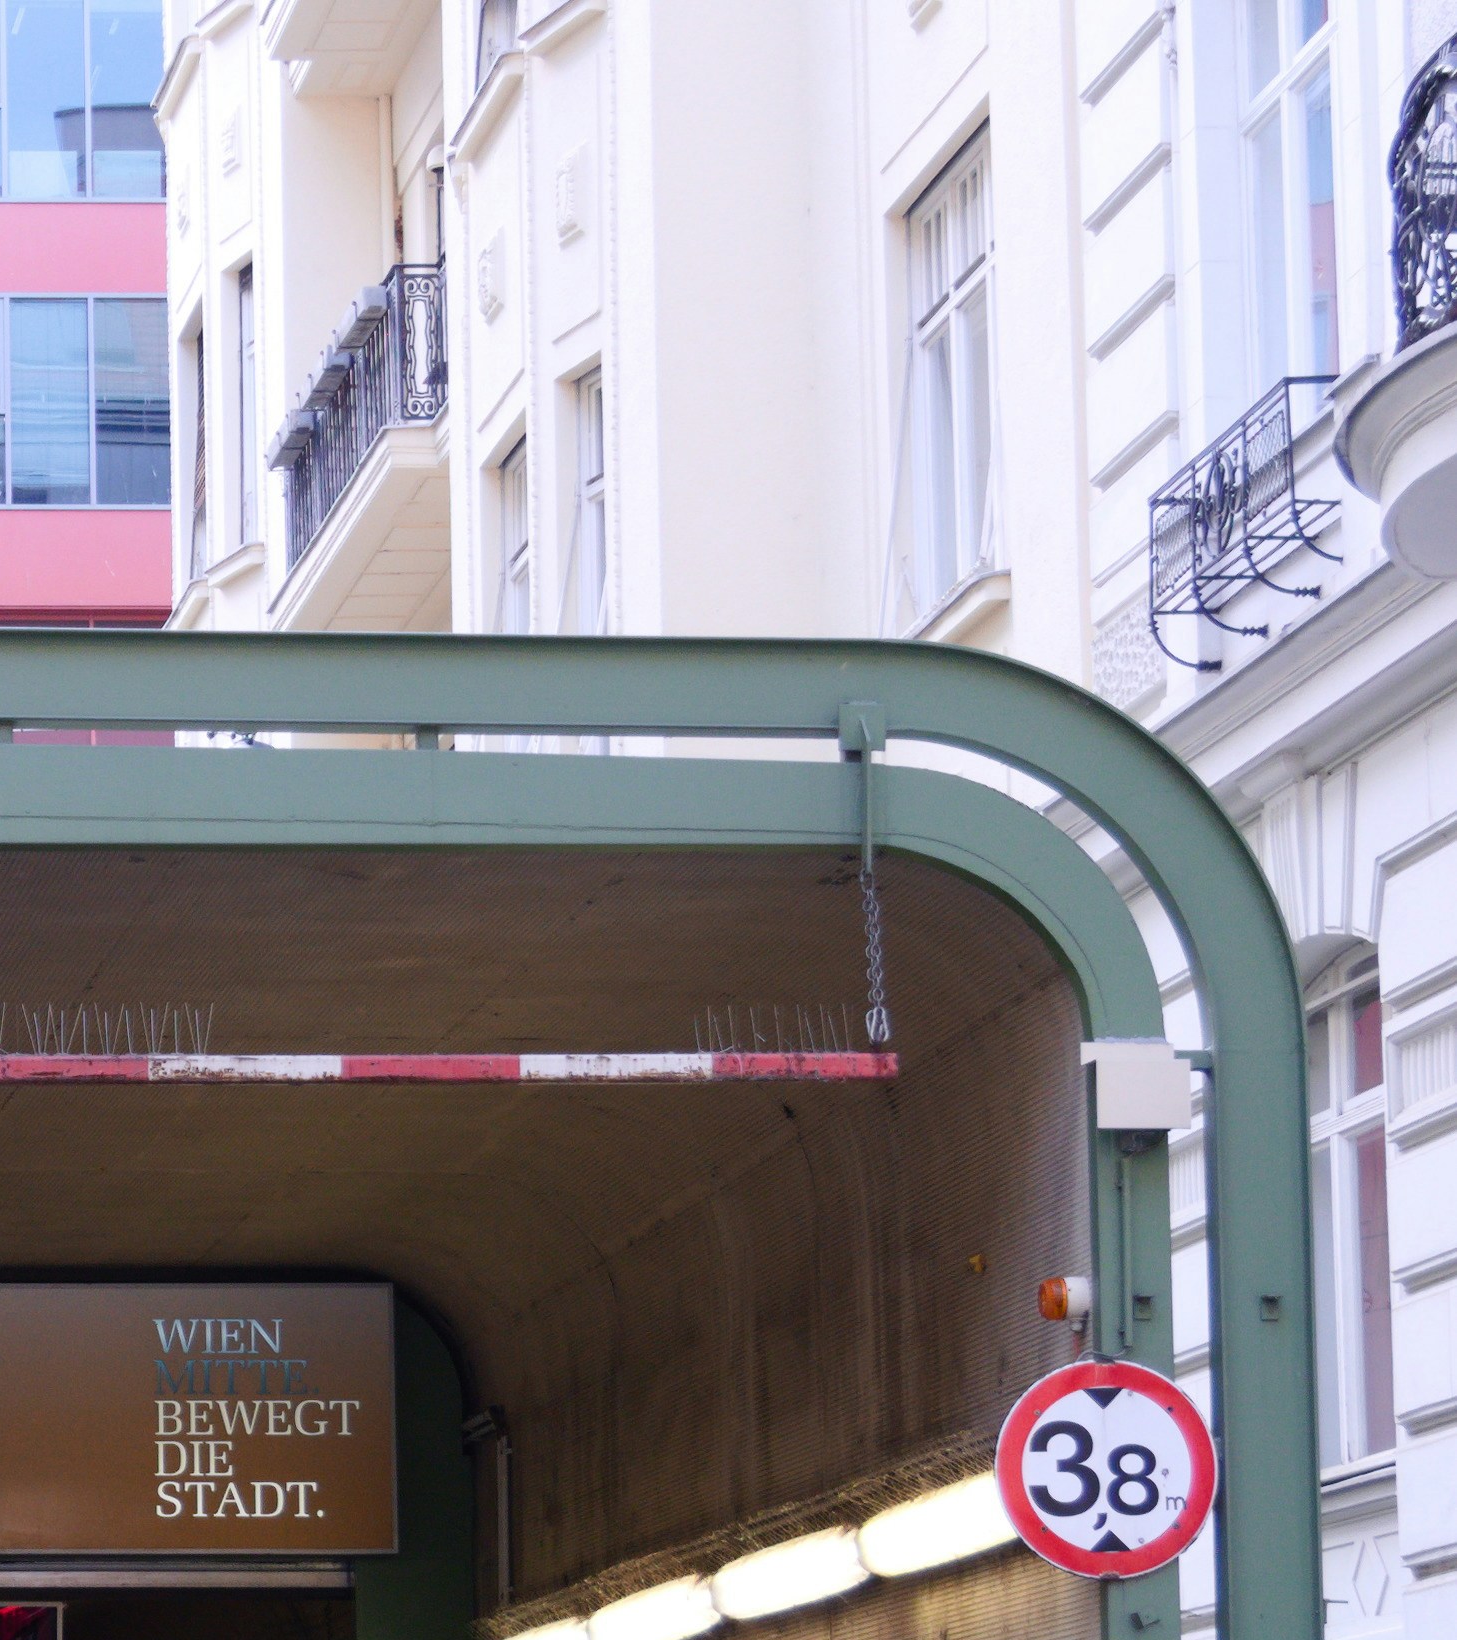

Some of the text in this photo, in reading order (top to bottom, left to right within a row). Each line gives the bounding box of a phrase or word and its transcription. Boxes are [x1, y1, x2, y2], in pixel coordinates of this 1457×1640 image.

[152, 1318, 284, 1354] WIEN
[153, 1359, 320, 1396] MITTE.
[154, 1400, 360, 1436] BEWEGT
[154, 1441, 234, 1477] DIE
[155, 1481, 325, 1519] STADT.
